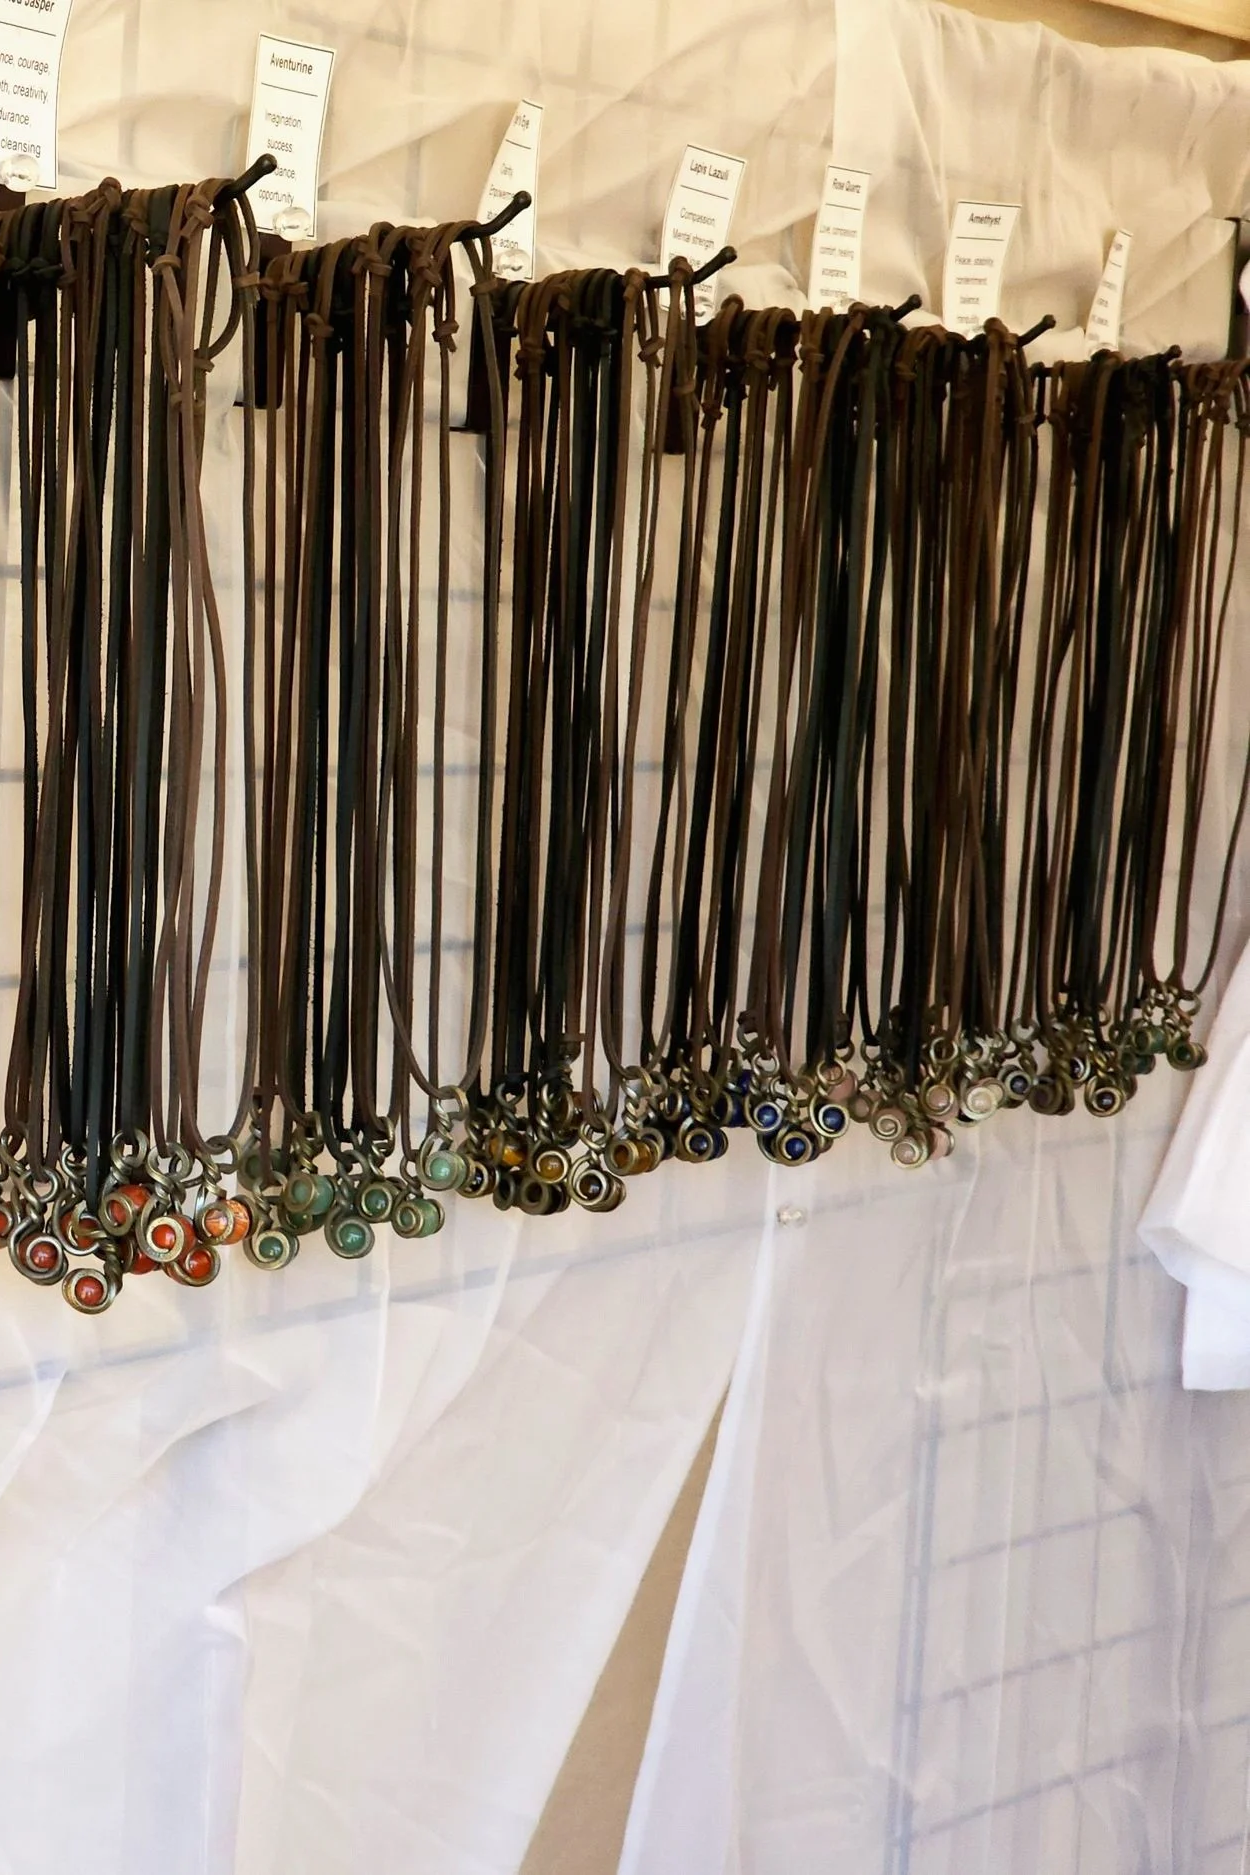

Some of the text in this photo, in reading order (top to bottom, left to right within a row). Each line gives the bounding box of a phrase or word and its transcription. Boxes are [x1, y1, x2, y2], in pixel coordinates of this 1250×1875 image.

[17, 56, 51, 76] courage,
[269, 52, 313, 75] Aventurine
[0, 136, 42, 158] cleansing
[690, 160, 730, 181] Lapis Lazuli
[832, 178, 862, 194] Rose Quartz
[969, 213, 1001, 227] Amethyst
